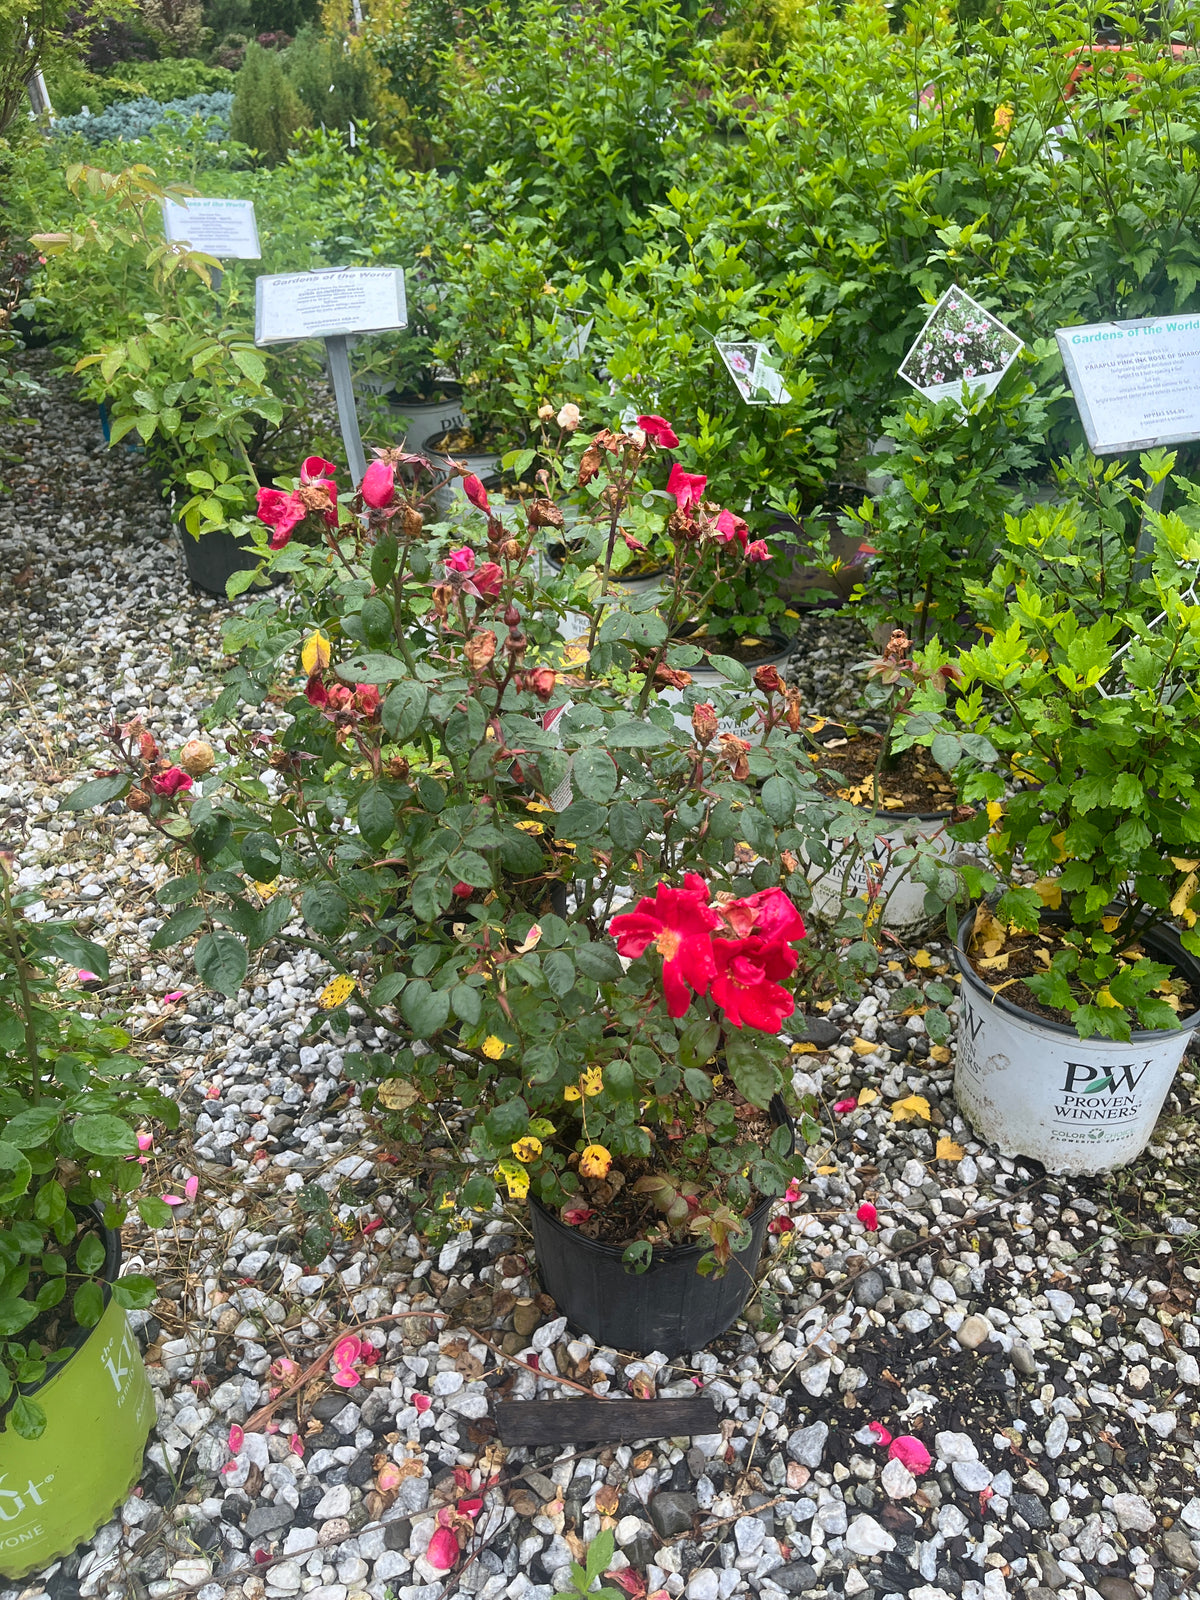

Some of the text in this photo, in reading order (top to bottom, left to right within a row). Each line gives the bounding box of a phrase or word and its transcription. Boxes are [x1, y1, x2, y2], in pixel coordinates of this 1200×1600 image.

[272, 276, 320, 286] Gardens
[1072, 319, 1200, 345] Gardens of the World
[1058, 1060, 1154, 1095] PW
[1064, 1094, 1136, 1108] PROVEN
[1051, 1129, 1086, 1140] COLOR
[101, 1337, 114, 1363] the
